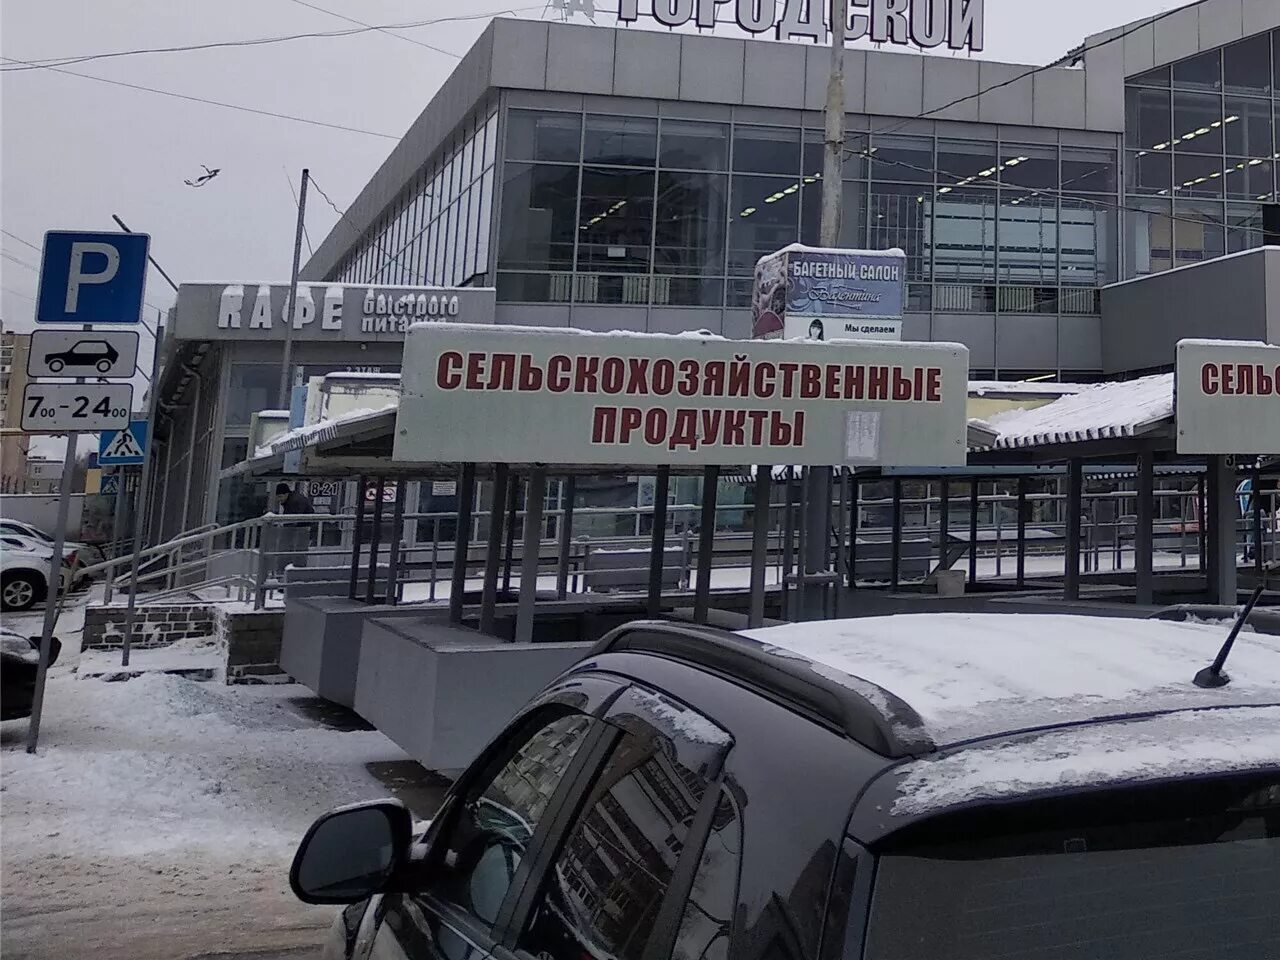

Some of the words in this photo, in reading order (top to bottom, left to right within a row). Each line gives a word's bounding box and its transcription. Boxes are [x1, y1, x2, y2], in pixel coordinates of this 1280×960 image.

[64, 242, 120, 313] P
[793, 259, 856, 280] БАГЕТНЫЙ
[859, 264, 899, 281] САЛОН
[218, 285, 343, 330] КАФЕ
[363, 290, 459, 316] быстрого
[845, 323, 859, 333] Мы
[861, 324, 895, 334] сделаем
[436, 350, 943, 403] СЕЛЬСКОХОЗЯЙСТВЕННЫЕ
[591, 406, 805, 452] ПРОДУКТЫ
[310, 481, 339, 496] 8-21
